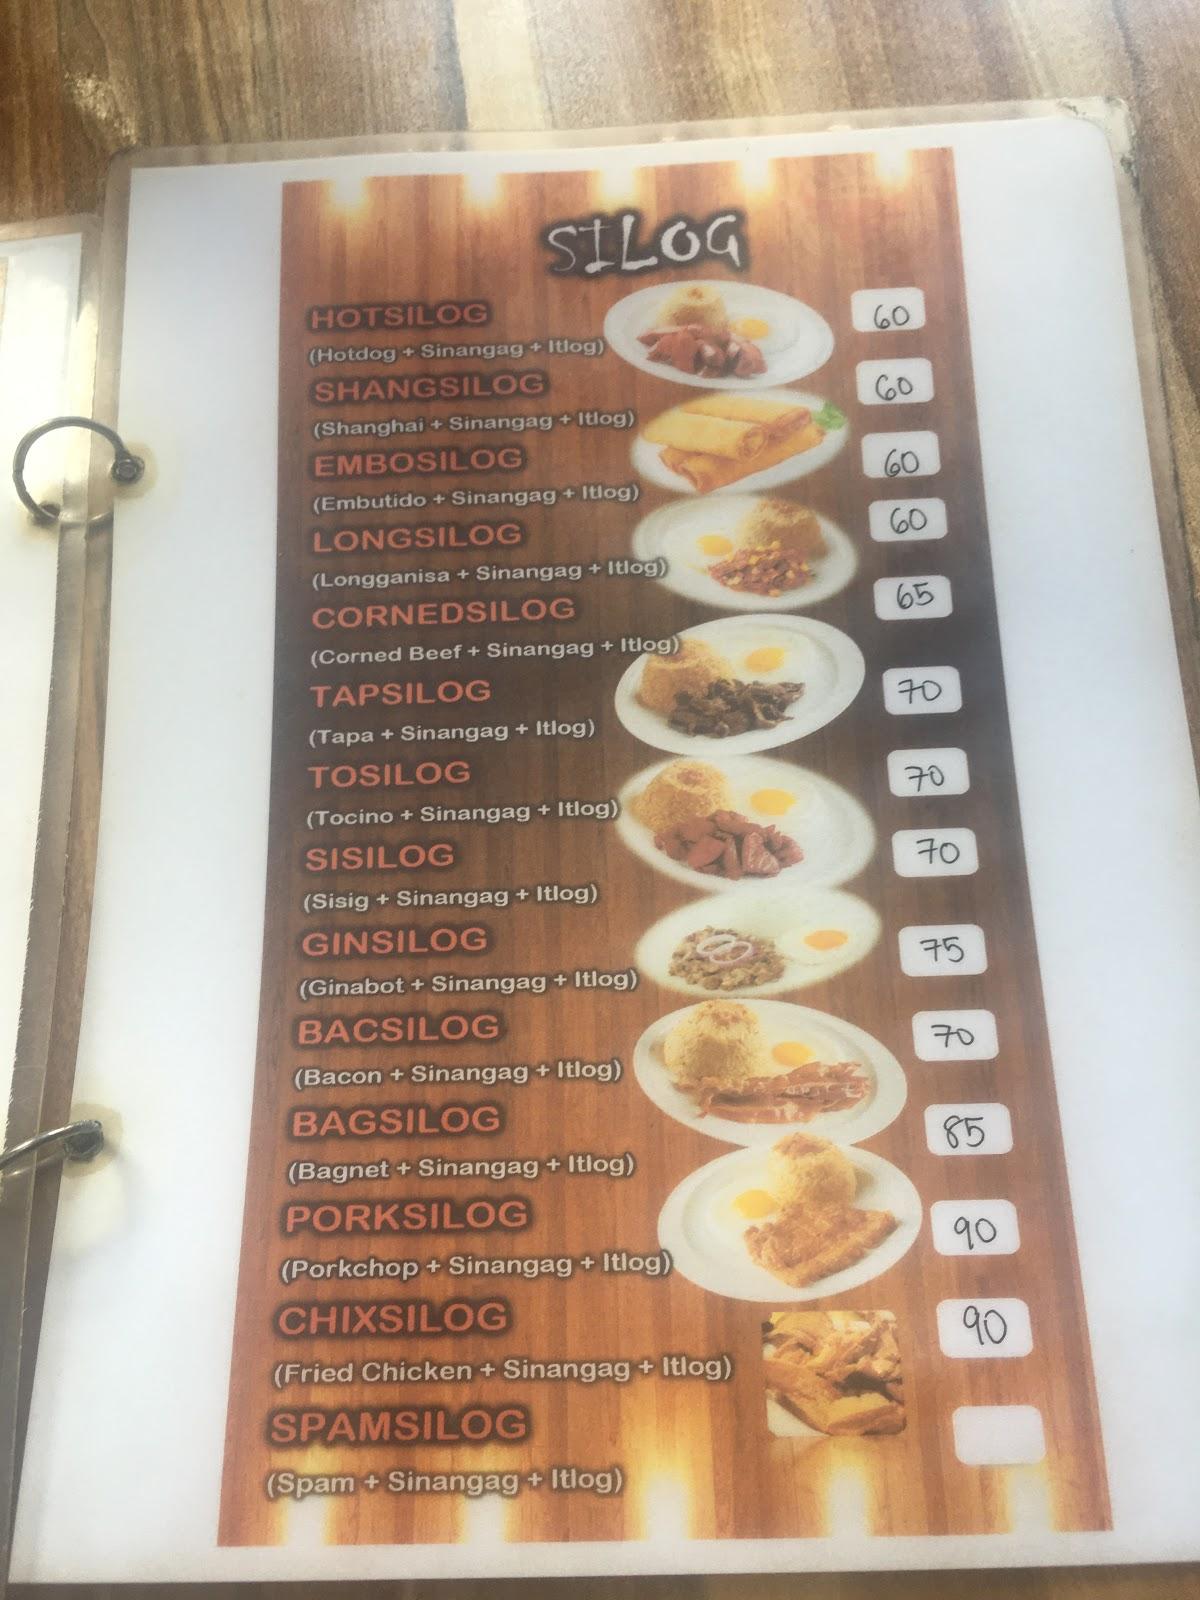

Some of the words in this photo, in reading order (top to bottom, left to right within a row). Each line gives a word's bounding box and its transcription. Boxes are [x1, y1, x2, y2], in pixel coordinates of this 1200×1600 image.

[548, 213, 744, 273] SILOG
[311, 303, 488, 330] HOTSILOG
[873, 304, 910, 330] 60
[309, 344, 397, 366] (Hotdog
[403, 347, 415, 357] +
[420, 340, 524, 361] Sinangag
[530, 341, 542, 353] +
[548, 337, 605, 357] Itlog)
[314, 374, 545, 403] SHANGSILOG
[875, 375, 914, 400] 60
[313, 417, 426, 439] (Shanghai
[432, 419, 444, 430] +
[449, 413, 553, 434] Sinangag
[559, 414, 572, 426] +
[577, 410, 635, 430] Itlog)
[314, 448, 523, 476] EMBOSILOG
[884, 448, 920, 477] 60
[313, 491, 427, 514] (Embutido
[433, 493, 445, 505] +
[451, 487, 556, 508] Sinangag
[562, 488, 575, 499] +
[582, 484, 639, 503] Itlog)
[889, 507, 928, 533] 60
[313, 524, 523, 553] LONGSILOG
[312, 567, 450, 590] (Longganisa
[457, 569, 469, 581] +
[476, 562, 583, 584] Sinangag
[589, 563, 602, 575] +
[607, 558, 668, 578] Itlog)
[895, 583, 934, 609] 65
[312, 599, 576, 630] CORNEDSILOG
[310, 643, 402, 668] (Corned
[409, 642, 462, 662] Beef
[467, 645, 481, 658] +
[487, 638, 594, 662] Sinangag
[600, 640, 614, 653] +
[620, 635, 680, 656] Itlog)
[310, 680, 491, 709] TAPSILOG
[898, 679, 943, 703] 70
[308, 725, 375, 748] (Tapa
[380, 728, 394, 740] +
[400, 721, 508, 743] Sinangag
[515, 723, 528, 736] +
[535, 718, 595, 739] Itlog)
[309, 761, 471, 790] TOSILOG
[904, 764, 946, 790] 70
[306, 805, 394, 829] (Tocino
[400, 809, 414, 822] +
[420, 802, 531, 825] Sinangag
[537, 804, 551, 816] +
[557, 799, 619, 820] Itlog)
[306, 844, 454, 872] SISILOG
[916, 839, 960, 865] 70
[303, 890, 369, 913] (Sisig
[376, 893, 390, 906] +
[396, 886, 509, 910] Sinangag
[515, 888, 530, 901] +
[536, 883, 598, 905] Itlog)
[302, 928, 487, 957] GINSILOG
[920, 936, 964, 964] 75
[299, 975, 404, 999] (Ginabot
[410, 978, 425, 990] +
[431, 972, 547, 995] Sinangag
[553, 974, 567, 987] +
[574, 969, 638, 991] Itlog)
[298, 1015, 500, 1045] BACSILOG
[931, 1024, 974, 1048] 70
[294, 1065, 384, 1089] (Bacon
[390, 1067, 404, 1081] +
[411, 1062, 528, 1087] Sinangag
[536, 1064, 551, 1078] +
[557, 1058, 622, 1082] Itlog)
[292, 1105, 501, 1138] BAGSILOG
[942, 1114, 985, 1148] 85
[288, 1160, 390, 1184] (Bagnet
[396, 1163, 411, 1177] +
[418, 1157, 539, 1181] Sinangag
[546, 1158, 561, 1172] +
[568, 1153, 635, 1177] Itlog)
[286, 1201, 528, 1233] PORKSILOG
[954, 1216, 997, 1246] 90
[280, 1255, 419, 1281] (Porkchop
[426, 1260, 441, 1274] +
[448, 1253, 573, 1279] Sinangag
[580, 1255, 596, 1269] +
[603, 1250, 672, 1274] Itlog)
[278, 1302, 508, 1335] CHIXSILOG
[963, 1305, 1008, 1345] 90
[273, 1360, 354, 1386] (Fried
[361, 1360, 473, 1382] Chicken
[480, 1363, 496, 1377] +
[503, 1357, 631, 1382] Sinangag
[639, 1360, 654, 1374] +
[662, 1354, 732, 1379] Itlog)
[270, 1410, 527, 1443] SPAMSILOG
[266, 1471, 355, 1497] (Spam
[364, 1476, 380, 1490] +
[387, 1469, 520, 1495] Sinangag
[527, 1472, 544, 1487] +
[551, 1466, 623, 1492] Itlog)
